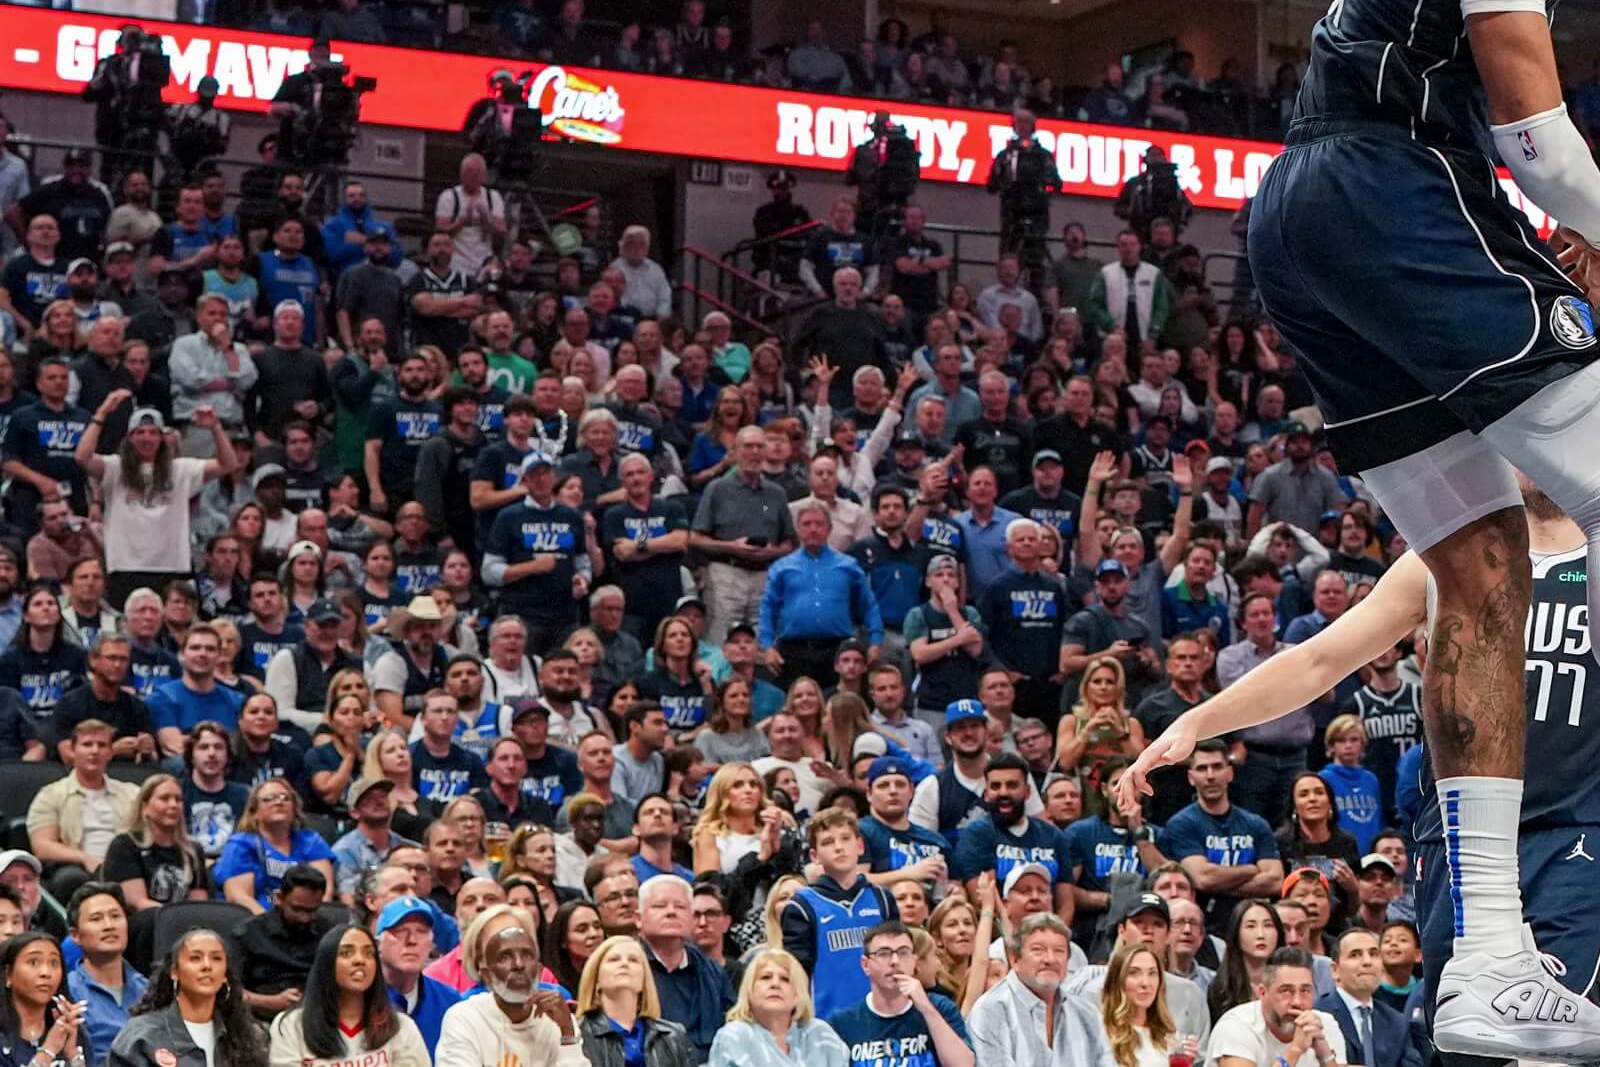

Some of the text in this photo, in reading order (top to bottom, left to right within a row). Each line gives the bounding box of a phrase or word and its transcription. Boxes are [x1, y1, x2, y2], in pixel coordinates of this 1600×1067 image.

[170, 33, 349, 101] MAV
[1214, 149, 1269, 201] LO
[1559, 570, 1587, 582] chi
[1526, 602, 1592, 656] VS
[1526, 658, 1587, 727] 77
[1364, 712, 1416, 739] MAVS
[1206, 834, 1255, 851] ONE FOR
[1492, 978, 1578, 1023] AIR
[851, 1034, 928, 1061] ONE FOR
